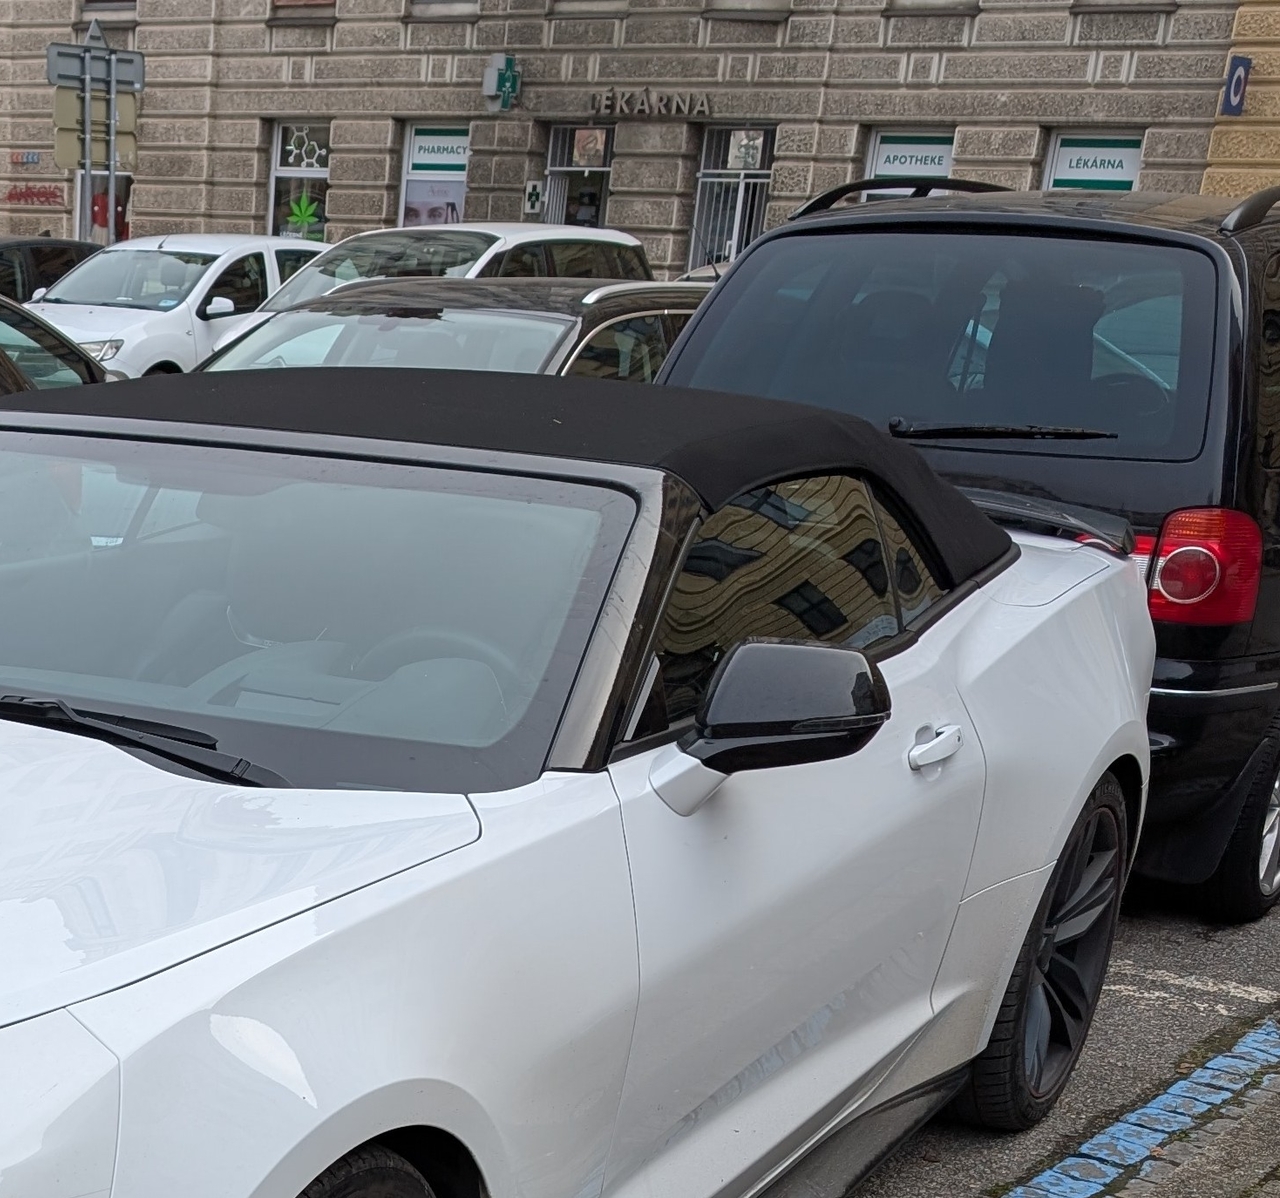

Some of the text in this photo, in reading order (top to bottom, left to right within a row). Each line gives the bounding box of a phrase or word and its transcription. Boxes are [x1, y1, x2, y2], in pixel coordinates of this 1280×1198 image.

[588, 86, 710, 115] LÉKÁRNA
[418, 145, 468, 154] PHARMACY
[883, 154, 944, 166] APOTHEKE
[1068, 156, 1124, 170] LÉKÁRNA
